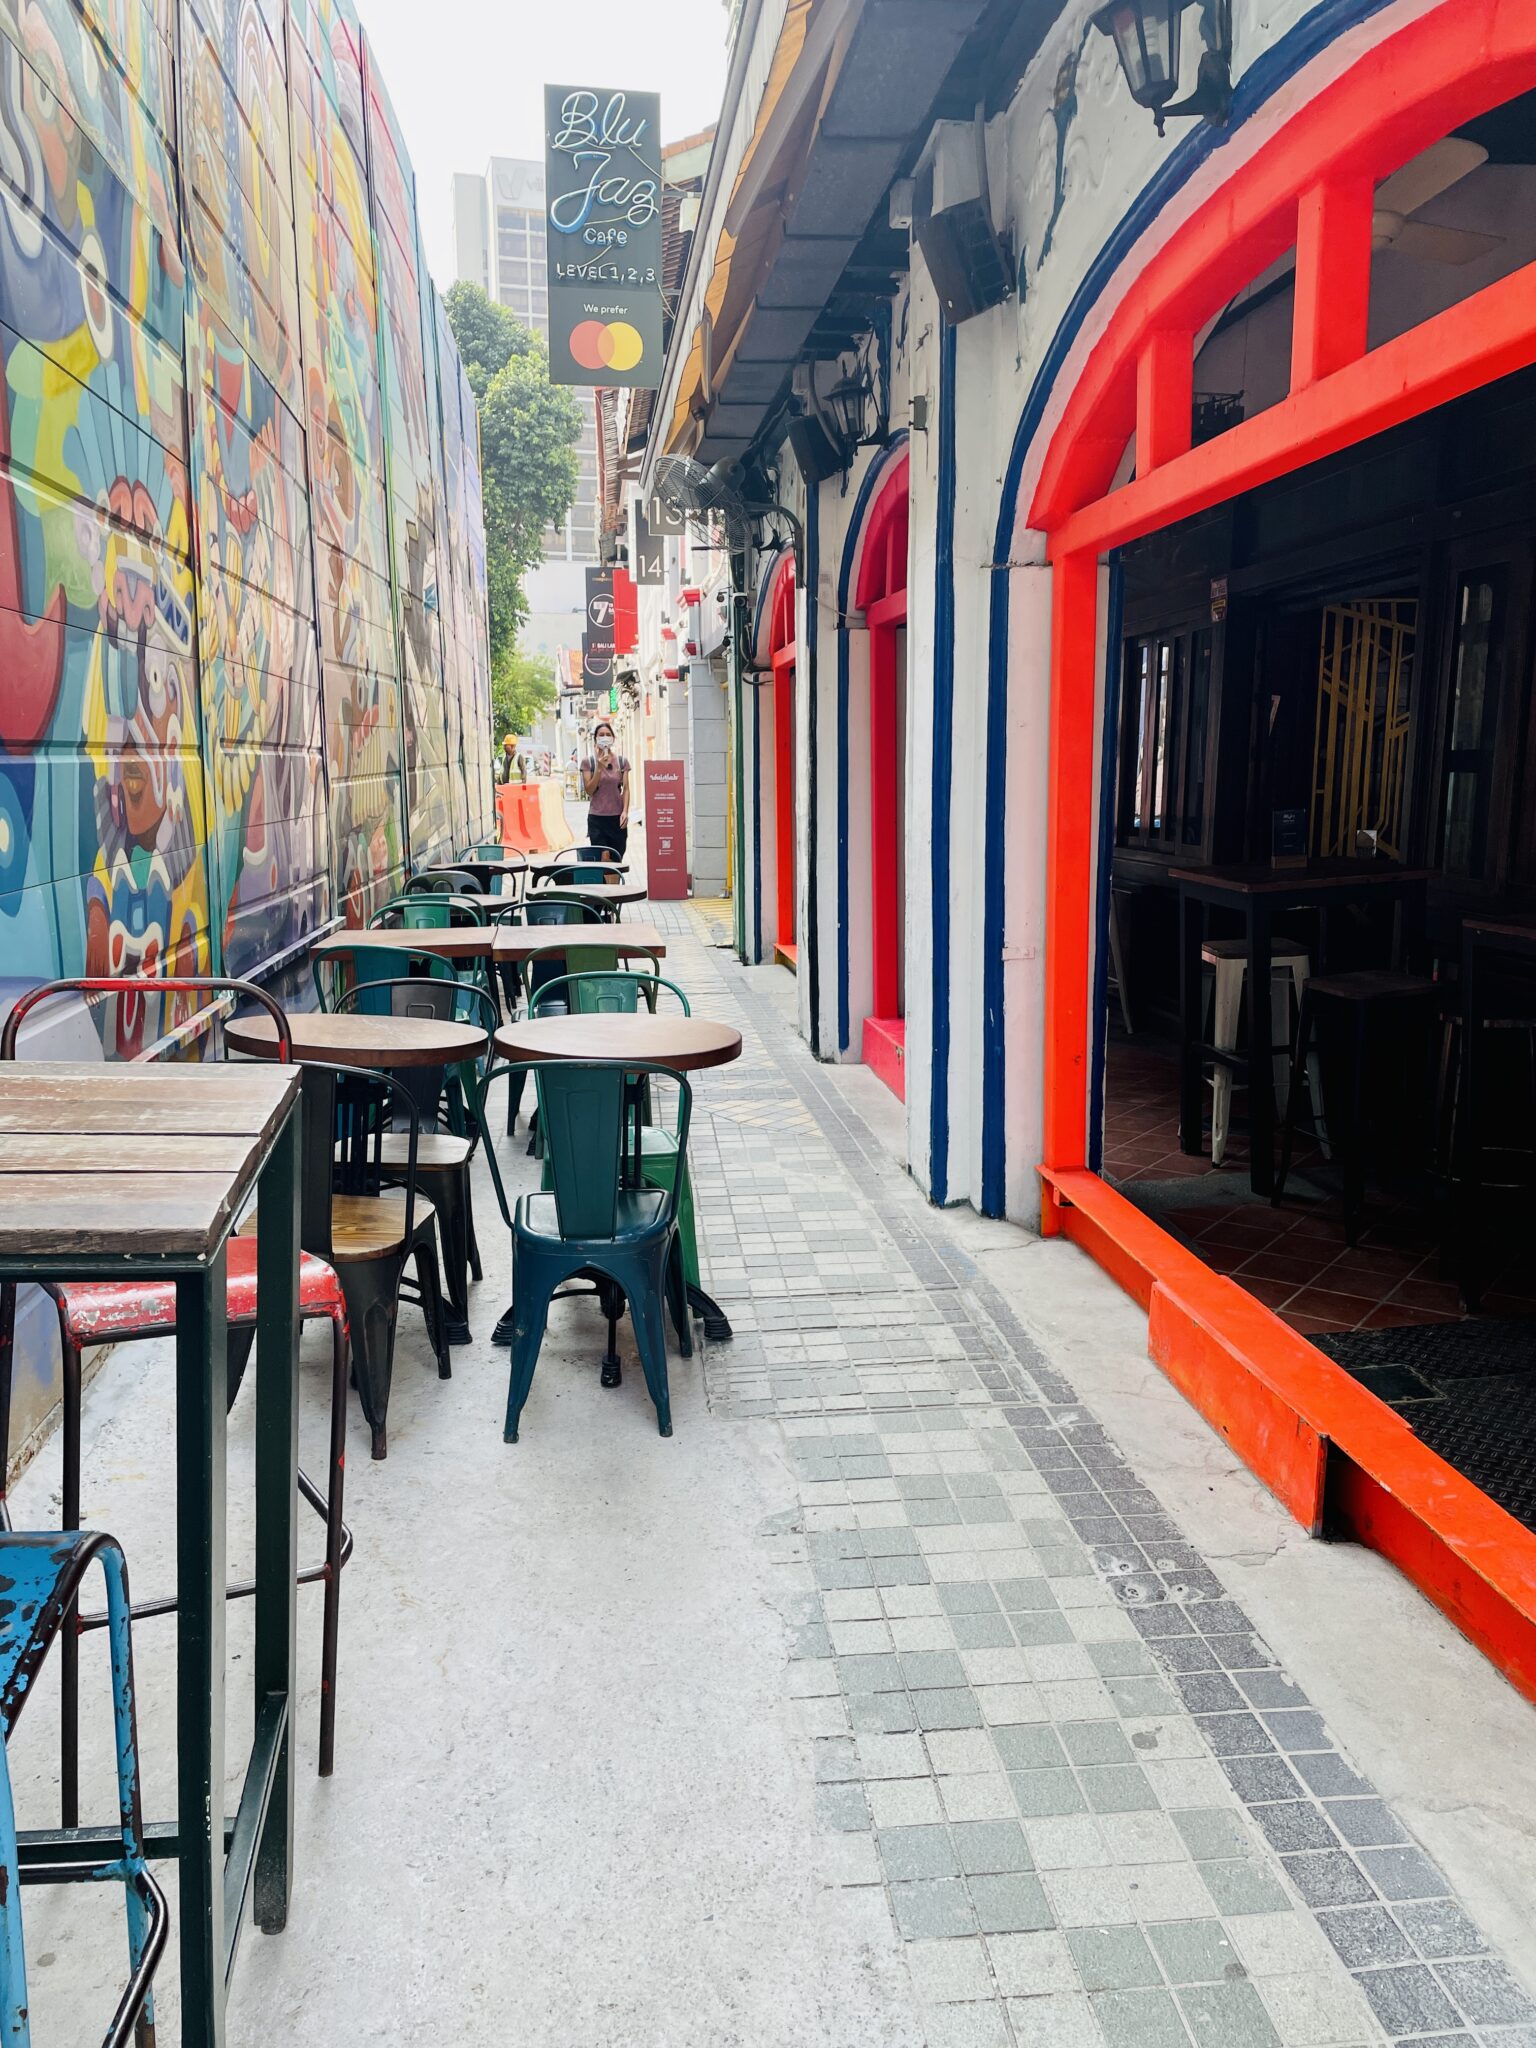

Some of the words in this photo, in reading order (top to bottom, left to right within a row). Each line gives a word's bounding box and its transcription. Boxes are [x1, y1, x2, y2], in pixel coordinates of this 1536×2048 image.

[551, 90, 645, 149] Blu
[550, 150, 660, 229] Jaz
[584, 227, 628, 245] Cafe
[556, 262, 608, 280] LEVEL
[583, 303, 599, 314] We
[600, 304, 628, 315] prefer
[639, 554, 663, 578] 14
